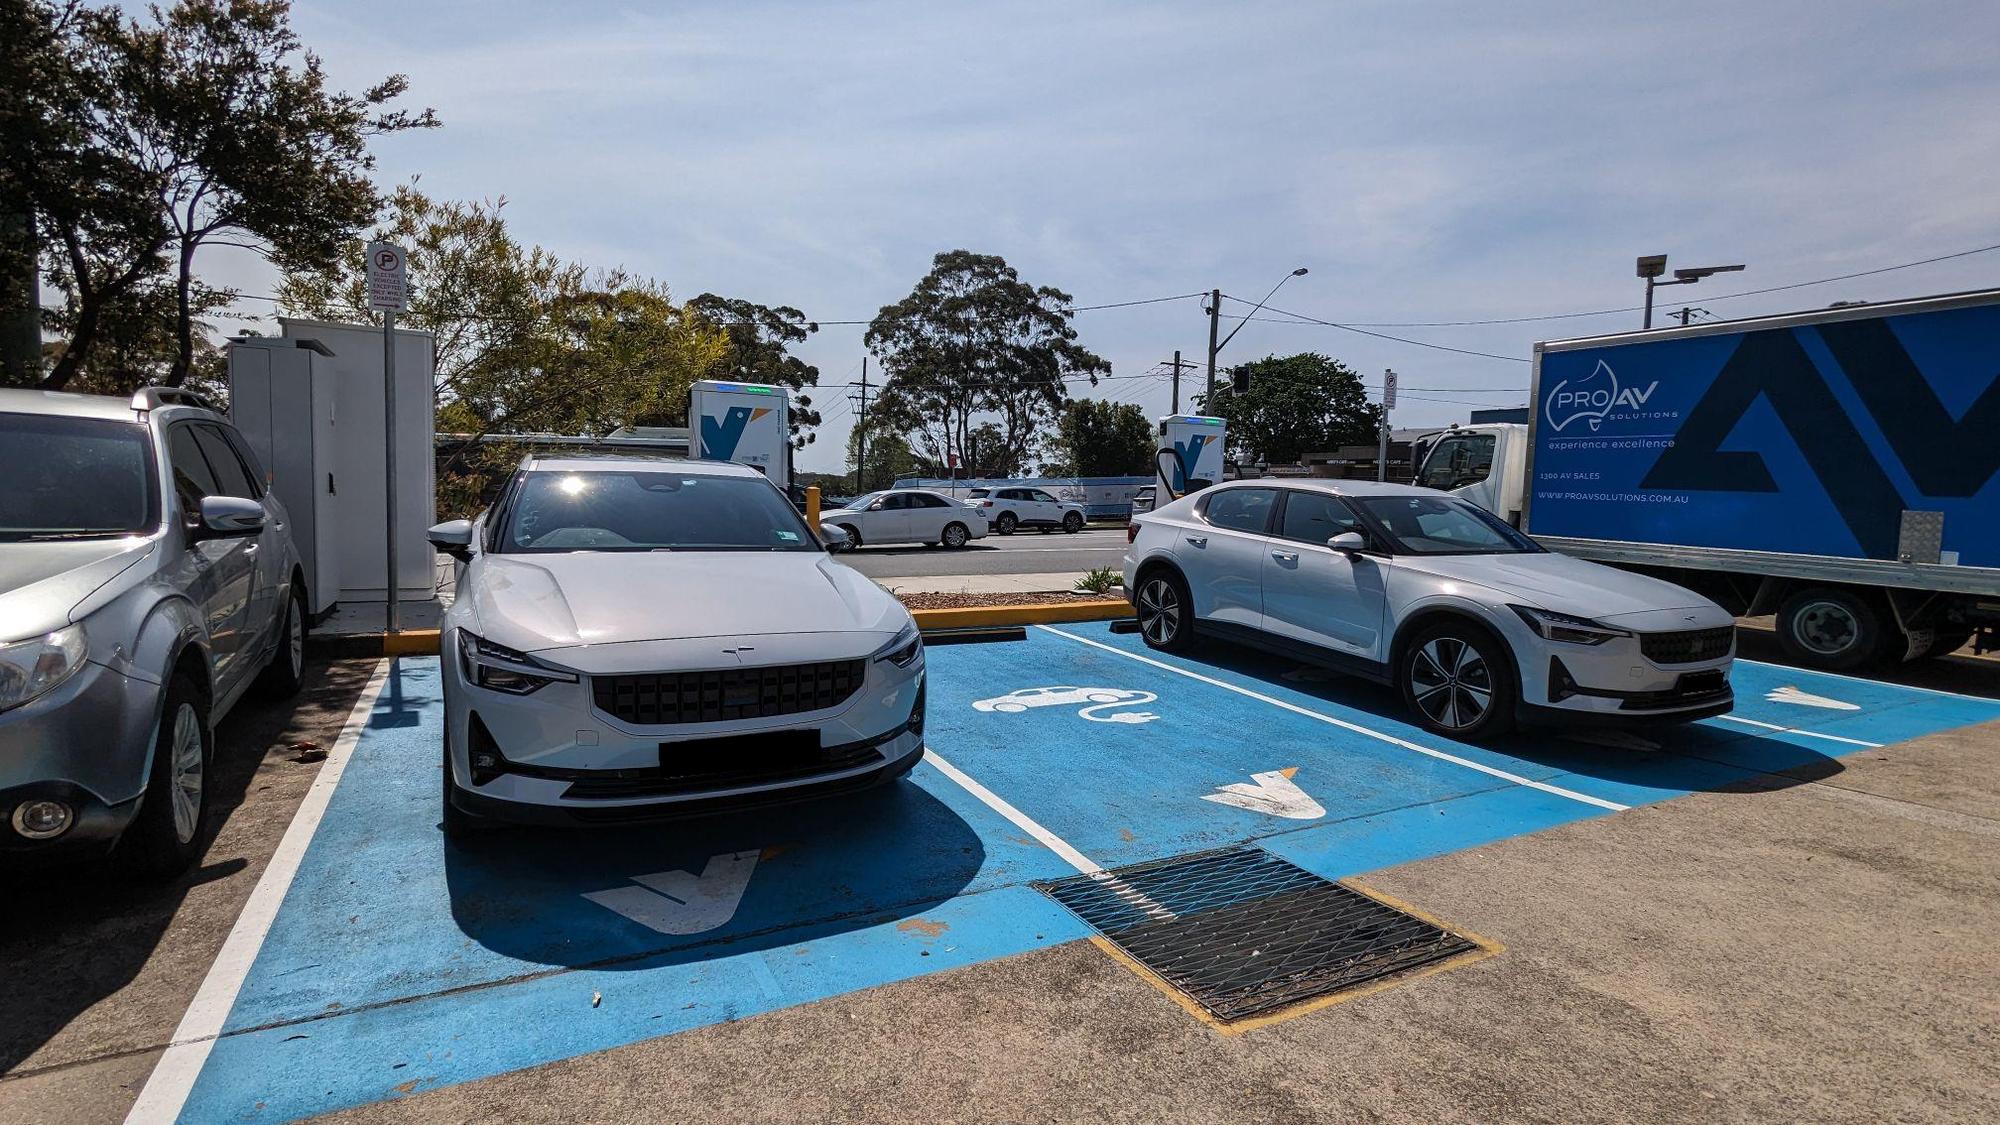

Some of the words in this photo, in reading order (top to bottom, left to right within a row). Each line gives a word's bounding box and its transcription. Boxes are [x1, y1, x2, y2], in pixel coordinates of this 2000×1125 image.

[1609, 411, 1678, 420] SOLUTIONS
[1548, 440, 1608, 451] experience
[1611, 439, 1675, 449] excellence
[1573, 472, 1600, 480] SALES
[1538, 491, 1689, 504] WWW.PROAVSOLUTIONS.COM.AU
